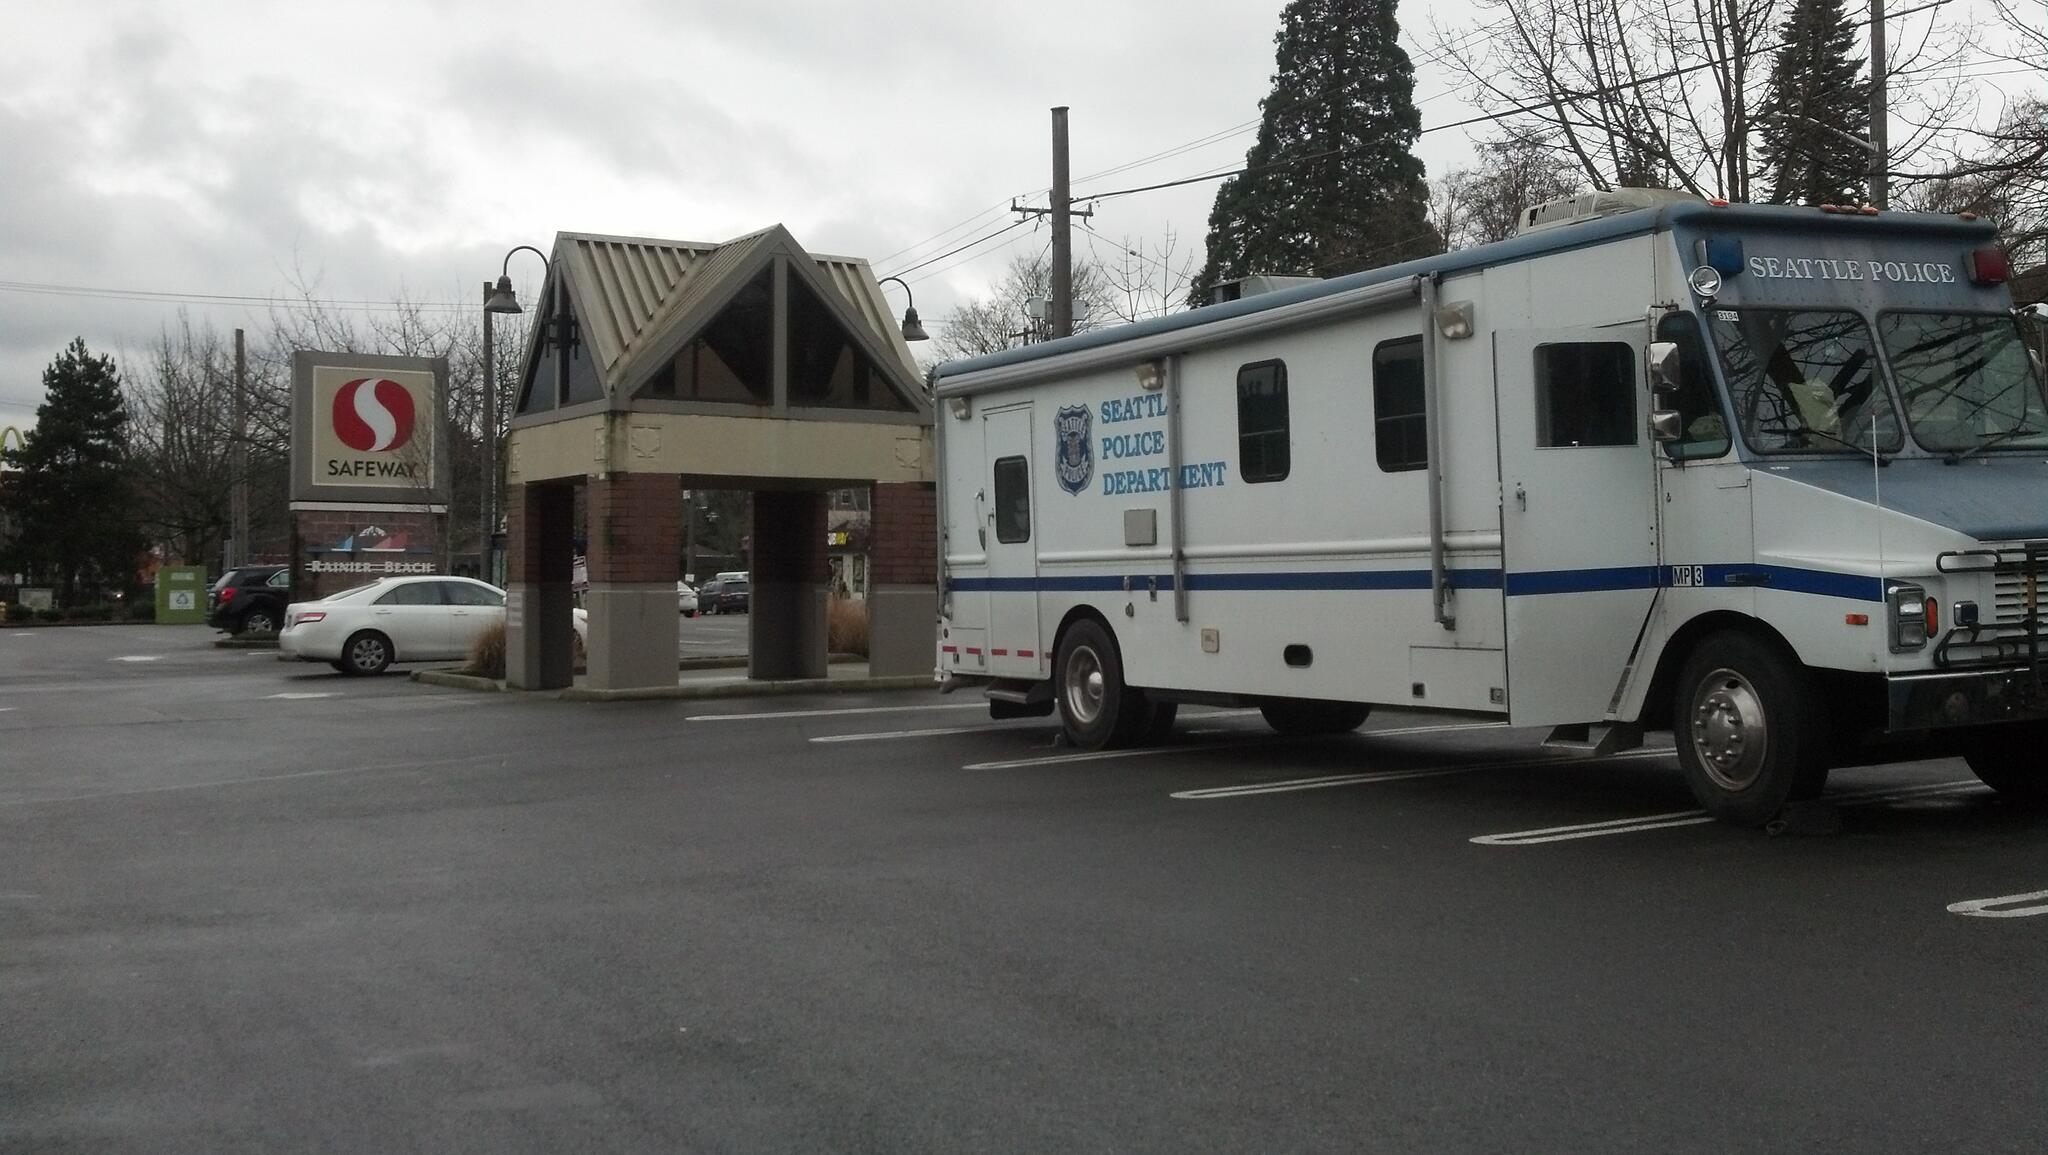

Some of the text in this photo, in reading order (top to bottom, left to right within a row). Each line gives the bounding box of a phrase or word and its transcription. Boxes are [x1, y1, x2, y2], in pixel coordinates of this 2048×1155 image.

[1749, 256, 1955, 283] SEATTLE POLICE
[1100, 393, 1169, 424] SEATTL
[1101, 430, 1165, 460] POLICE
[327, 459, 418, 478] SAFEWAY
[311, 560, 431, 573] RAINIER BEACH
[1673, 567, 1703, 585] MP 3
